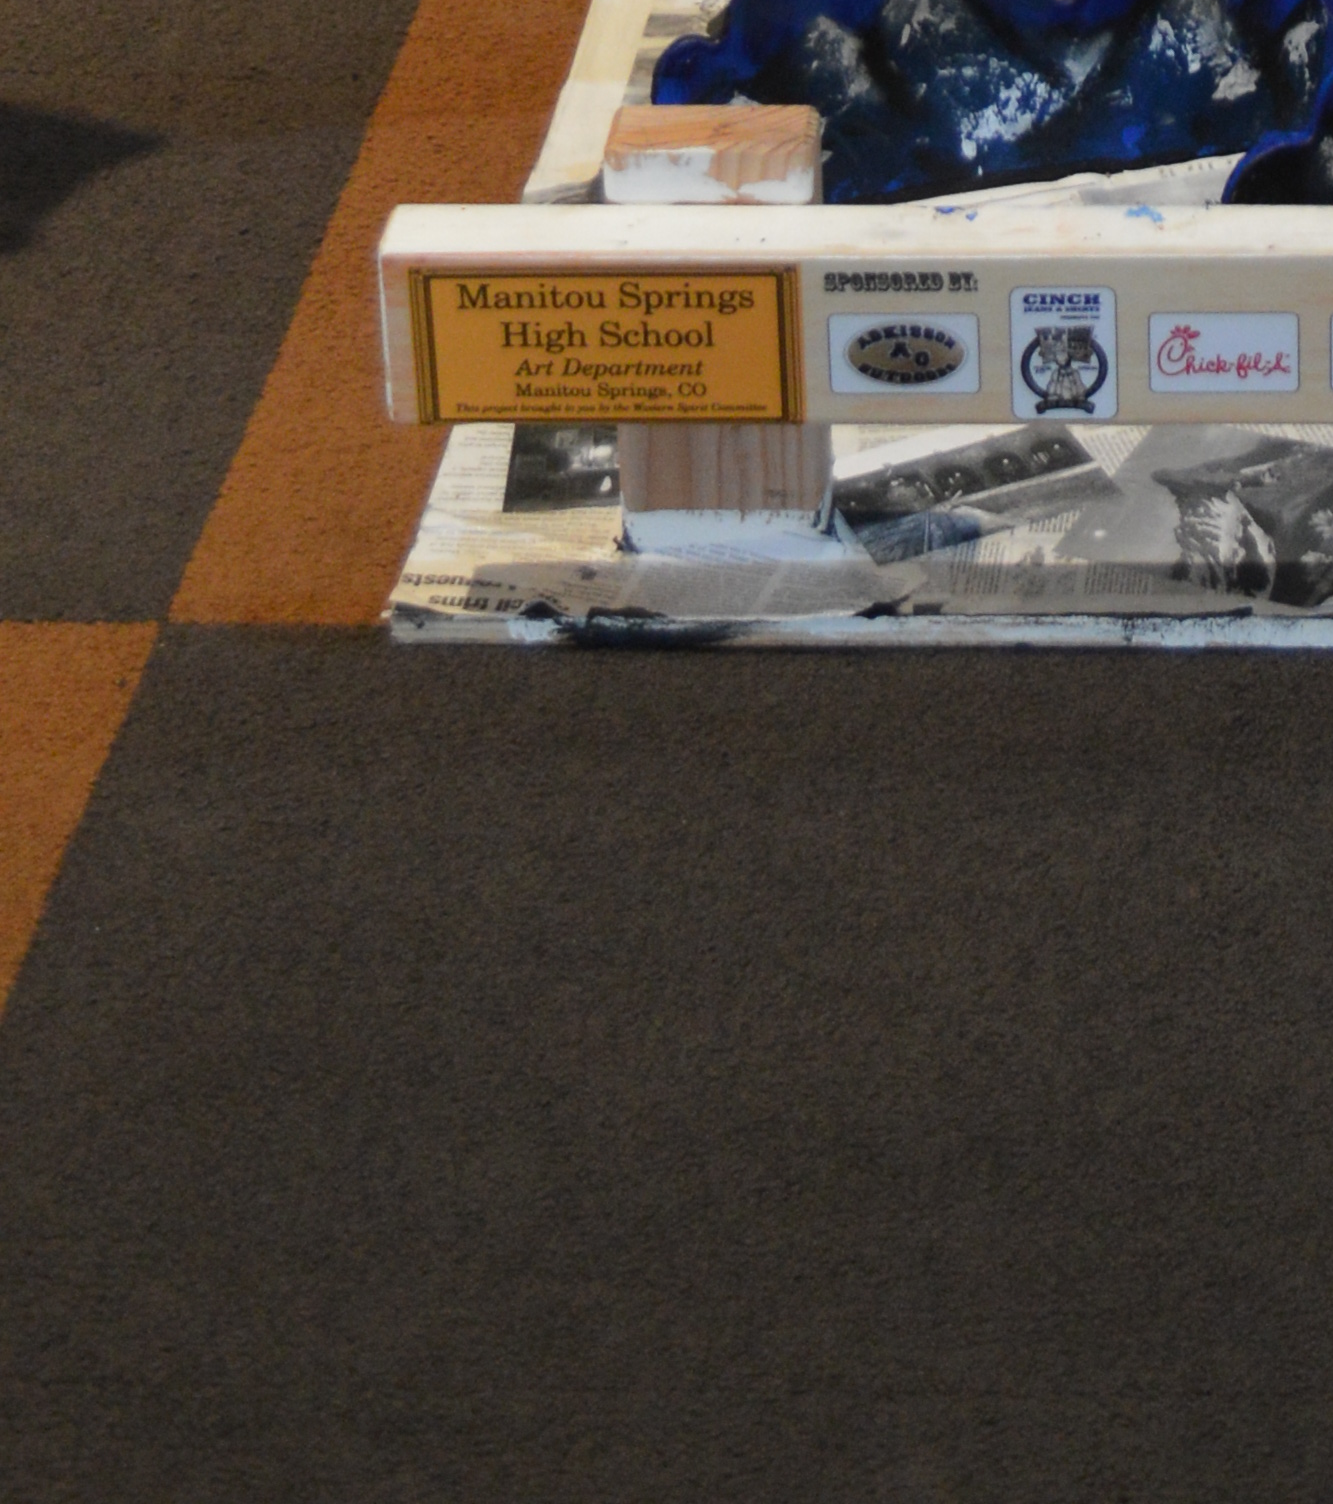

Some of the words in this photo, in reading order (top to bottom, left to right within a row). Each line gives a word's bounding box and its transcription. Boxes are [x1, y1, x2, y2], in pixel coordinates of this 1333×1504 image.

[824, 272, 944, 292] SPONSORED
[947, 272, 979, 292] BY:
[456, 282, 606, 310] Manitou
[618, 281, 755, 315] Springs
[1022, 293, 1101, 306] CINCH
[501, 320, 587, 353] High
[599, 320, 715, 348] School
[515, 358, 554, 376] Art
[562, 357, 704, 380] Department
[515, 383, 591, 398] Manitou
[597, 382, 672, 400] Springs,
[677, 382, 707, 397] CO
[456, 403, 479, 413] This
[612, 402, 630, 413] the
